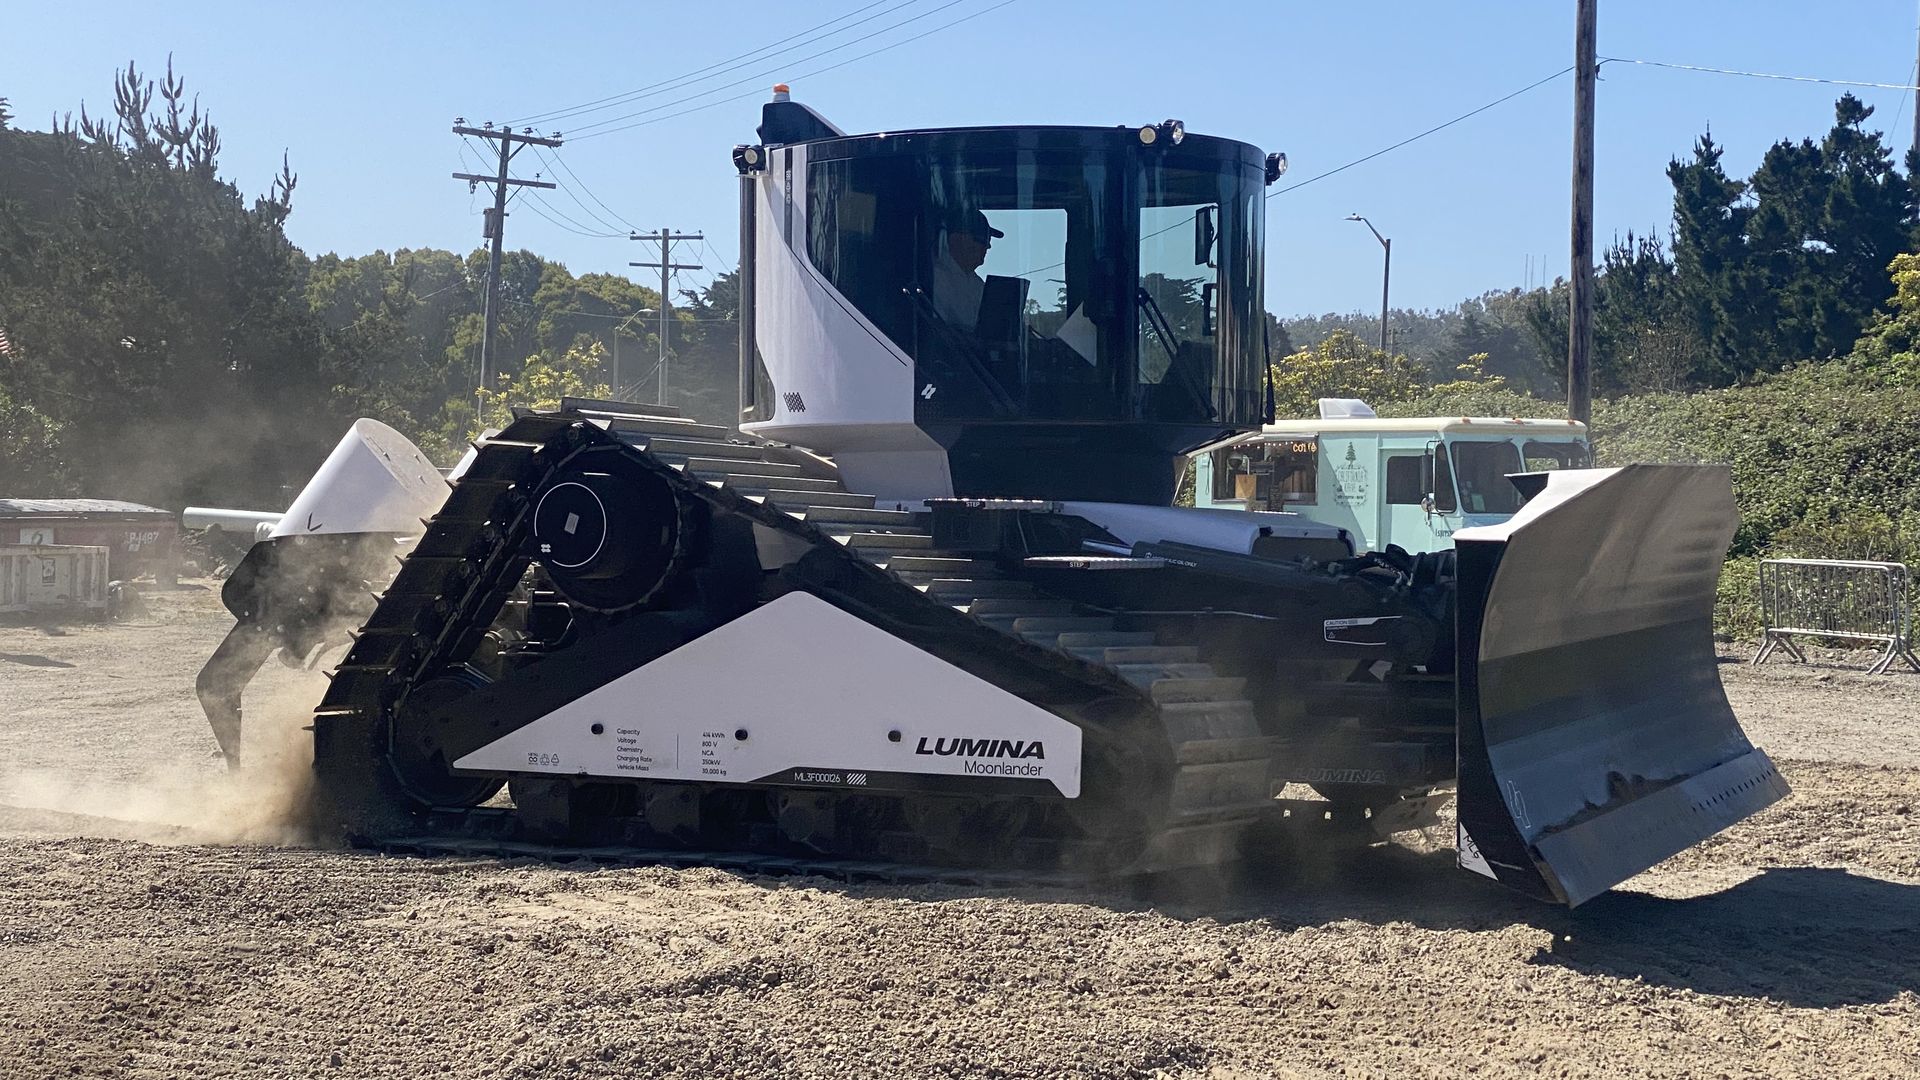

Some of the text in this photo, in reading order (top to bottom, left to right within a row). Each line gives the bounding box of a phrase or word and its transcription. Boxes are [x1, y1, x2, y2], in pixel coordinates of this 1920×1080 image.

[617, 728, 640, 736] Capacity
[915, 737, 1045, 759] LUMINA
[617, 755, 639, 763] Charging
[964, 760, 1043, 776] Moonlander
[1463, 835, 1480, 859] ML6
